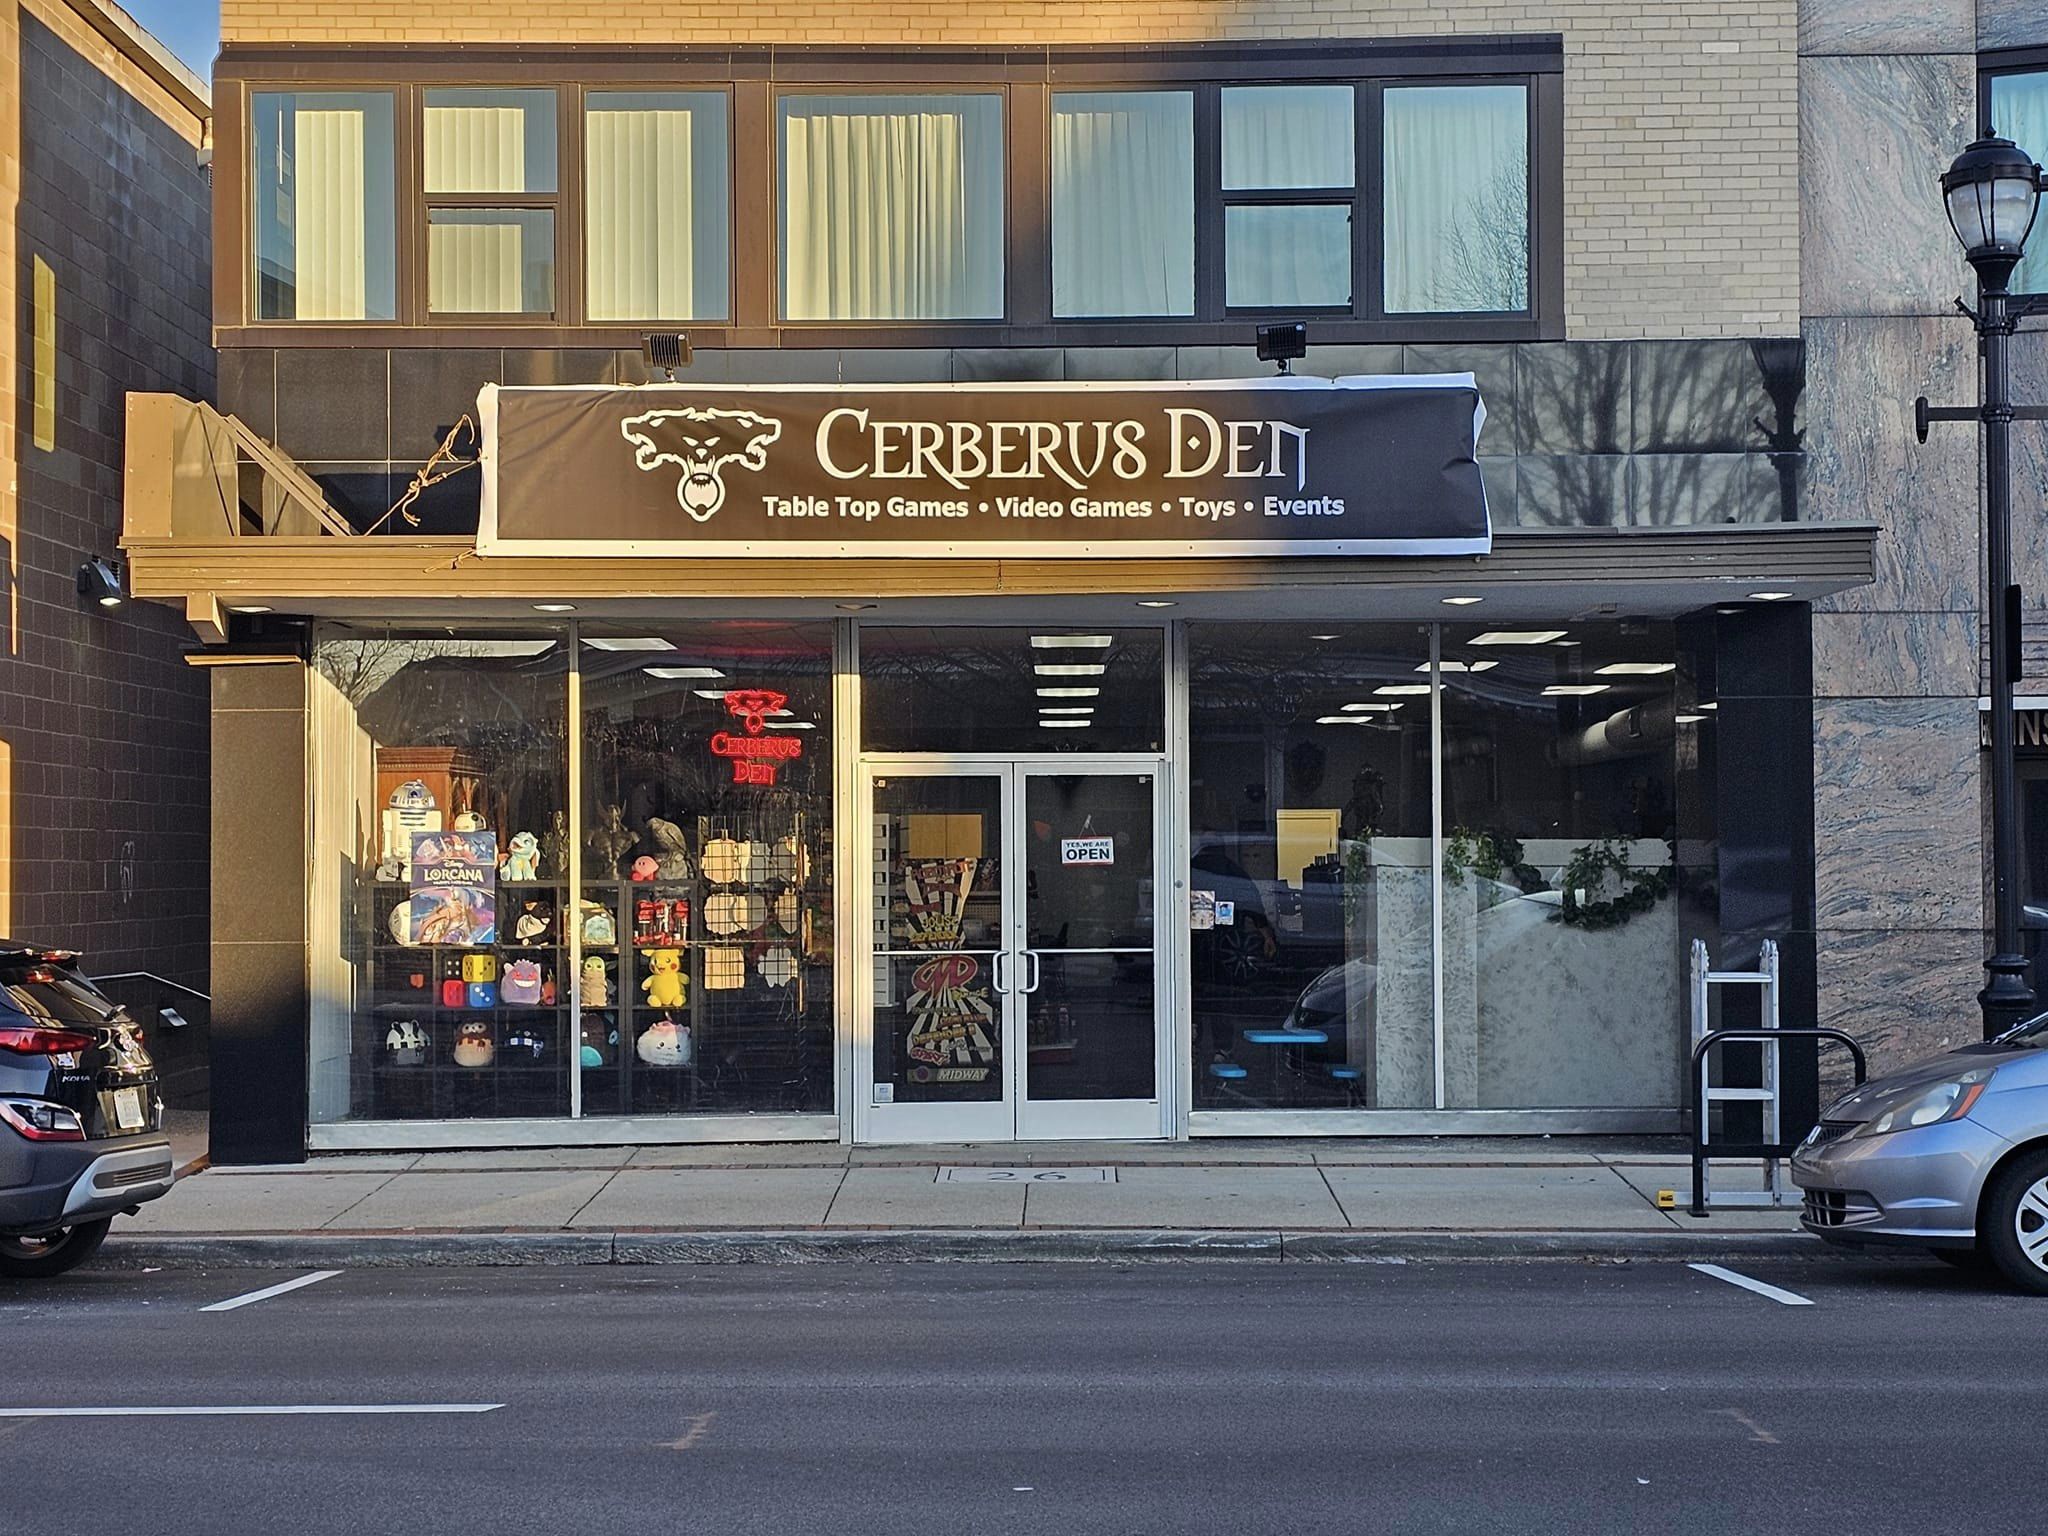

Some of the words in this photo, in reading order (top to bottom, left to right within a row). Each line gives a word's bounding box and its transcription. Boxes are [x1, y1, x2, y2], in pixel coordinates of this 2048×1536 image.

[816, 408, 1147, 489] CERBERUS
[1163, 408, 1310, 492] DEN
[762, 496, 829, 517] Table
[835, 497, 880, 521] Top
[887, 497, 968, 517] Games
[996, 496, 1063, 517] Video
[1070, 497, 1152, 517] Games
[1179, 497, 1236, 521] Toys
[1264, 496, 1345, 516] Events
[711, 732, 802, 759] CERBERUS
[733, 760, 776, 785] DEN
[1066, 848, 1110, 860] OPEN
[424, 868, 485, 882] LORCANA
[939, 1068, 987, 1081] MIDWAY
[987, 1171, 1067, 1181] 26
